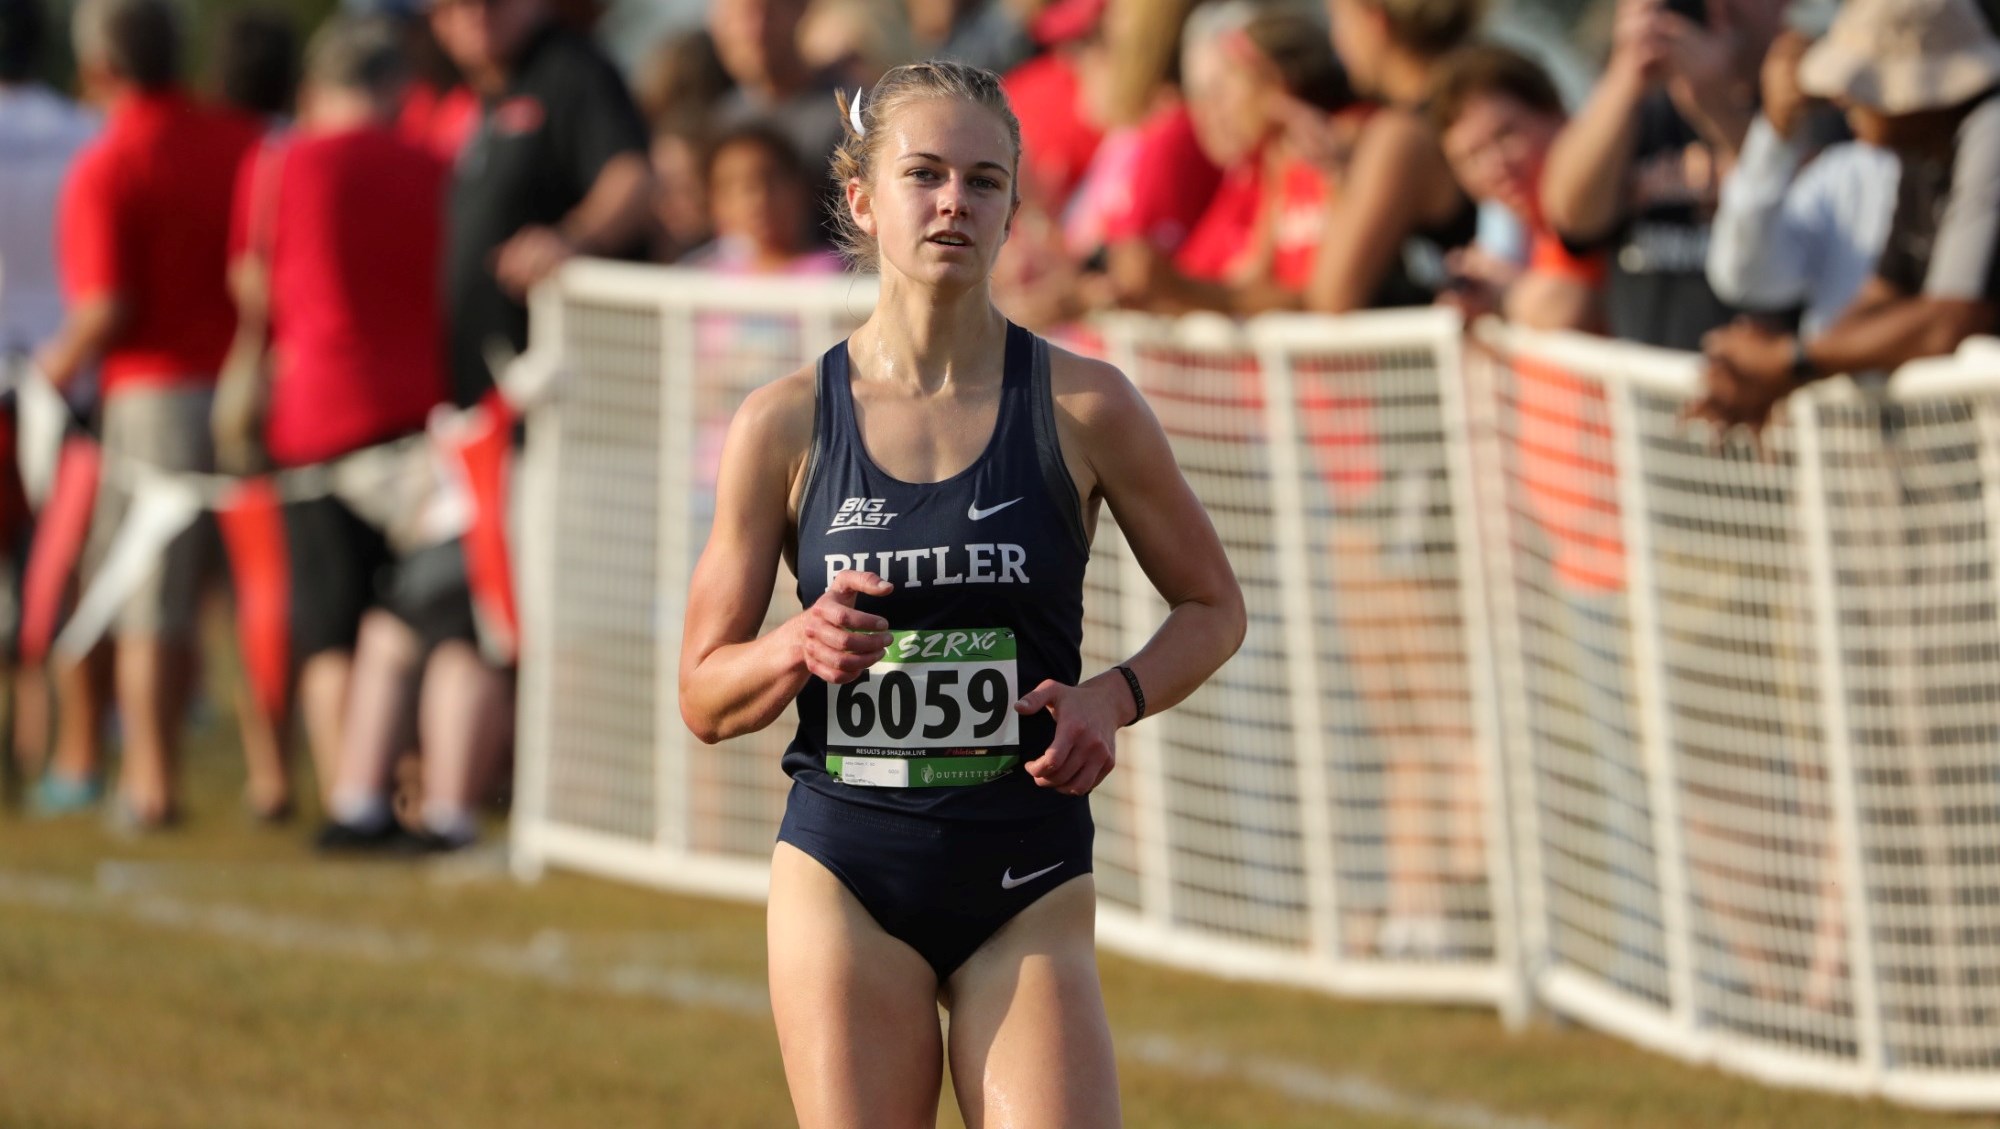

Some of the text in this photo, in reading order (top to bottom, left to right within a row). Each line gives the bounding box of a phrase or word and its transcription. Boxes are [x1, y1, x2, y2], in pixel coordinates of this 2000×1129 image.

[838, 497, 887, 513] BIG
[830, 512, 899, 528] EAST
[898, 631, 968, 659] SZR
[836, 668, 1009, 740] 6059
[855, 748, 881, 756] RESULTS
[886, 749, 927, 757] SHAZAM.LIVE
